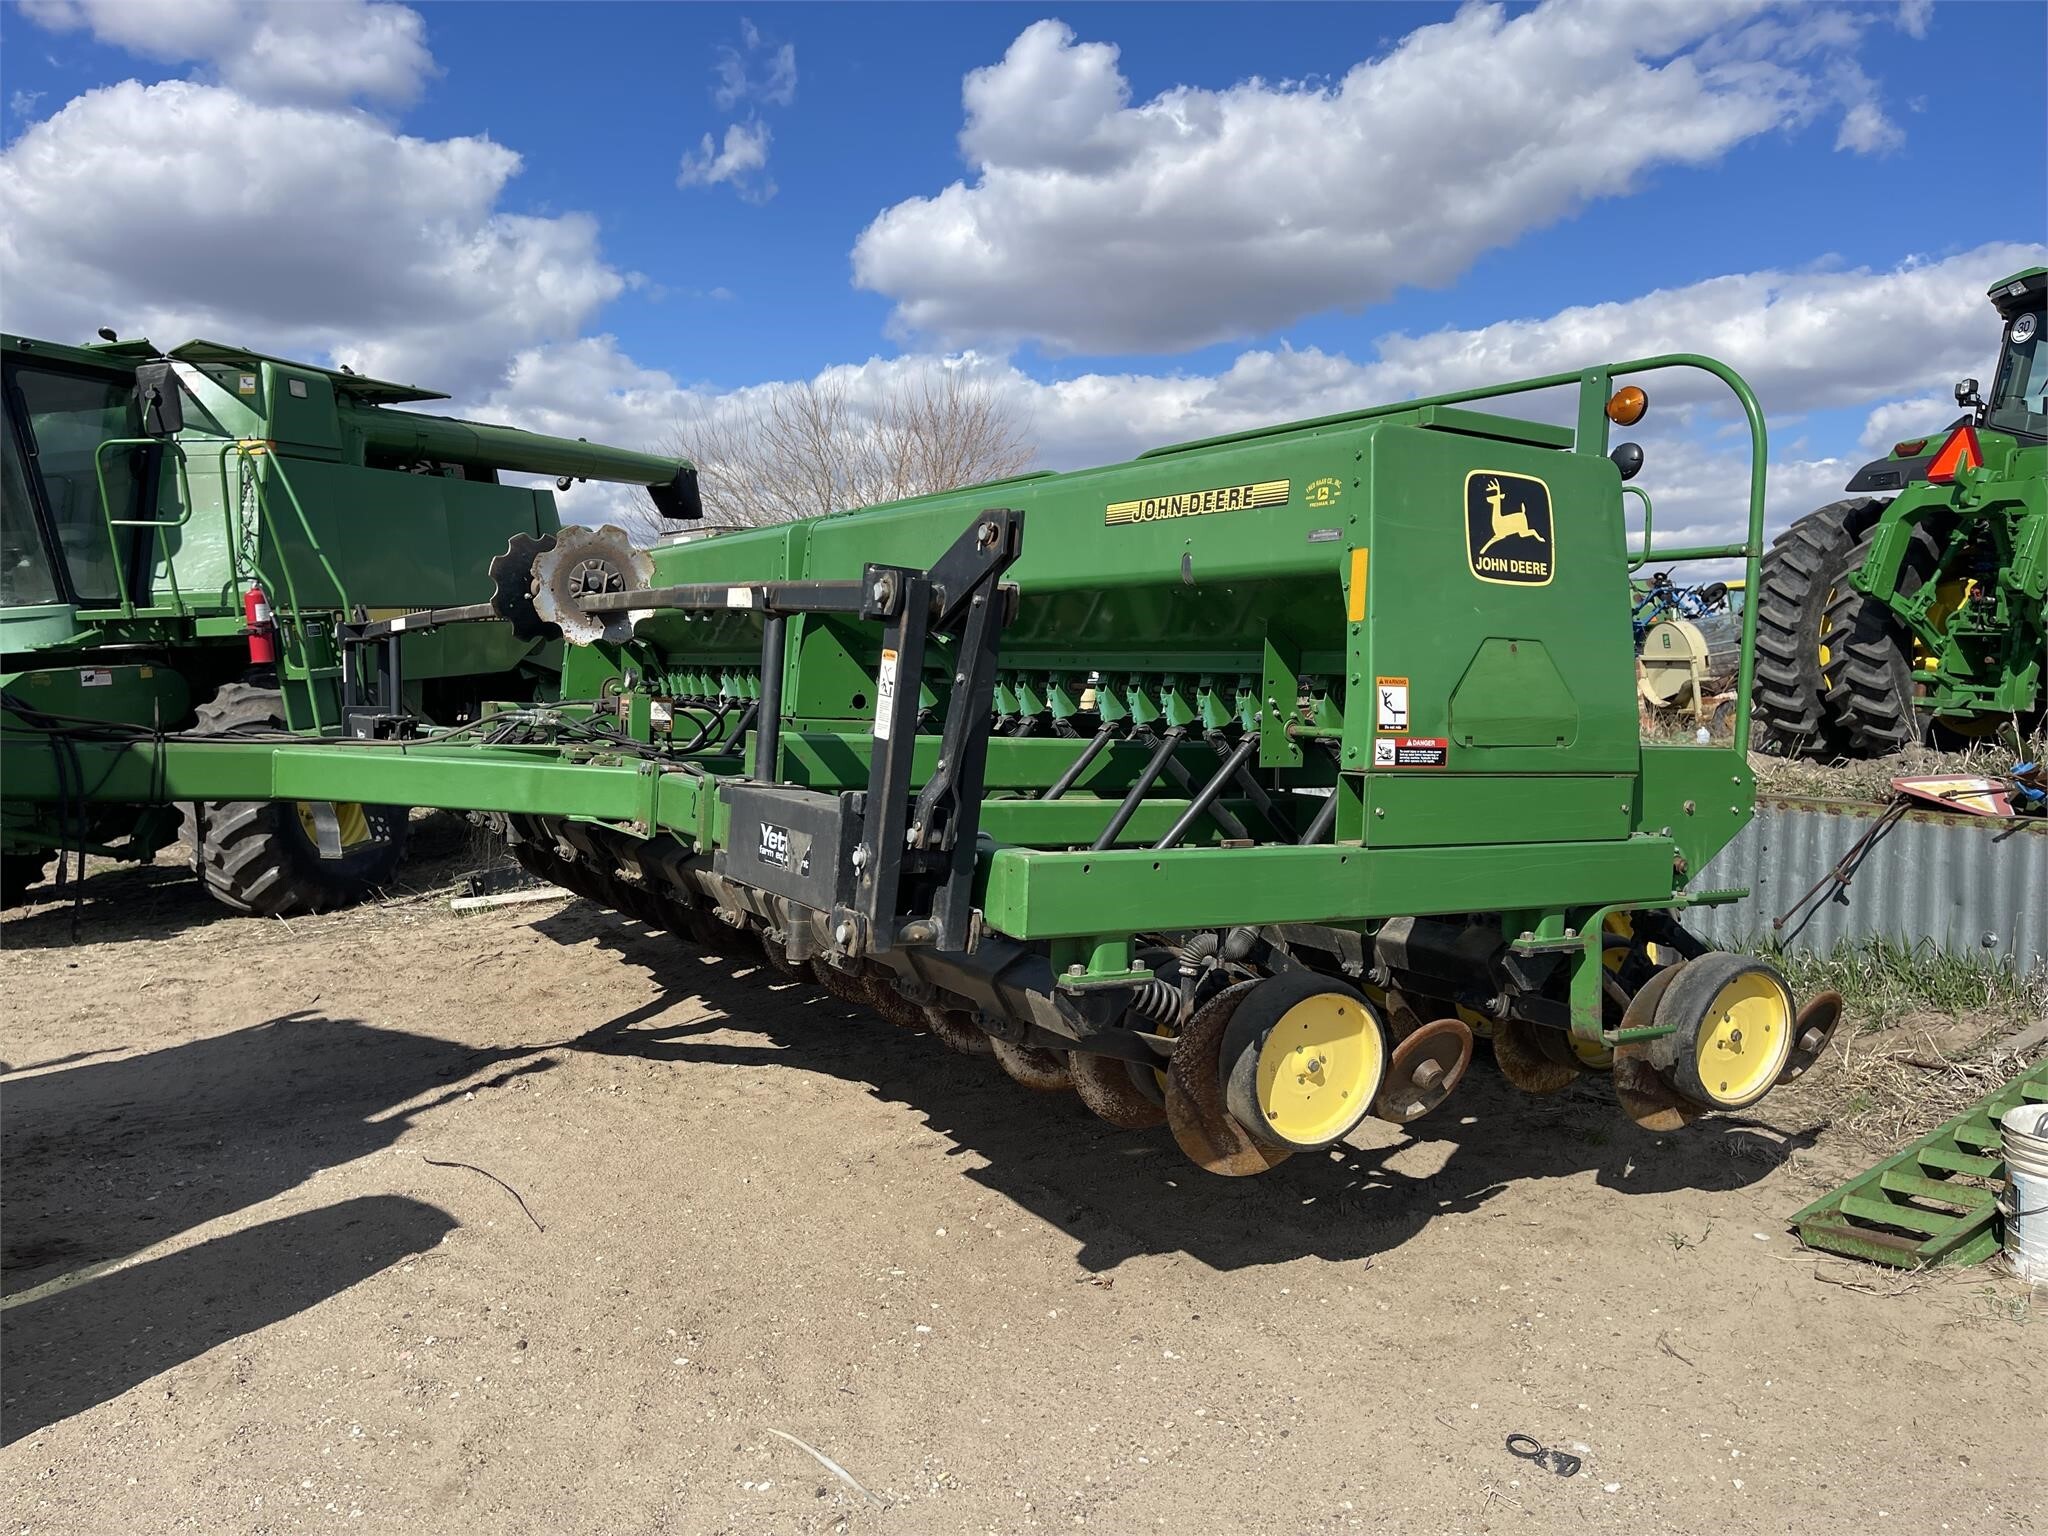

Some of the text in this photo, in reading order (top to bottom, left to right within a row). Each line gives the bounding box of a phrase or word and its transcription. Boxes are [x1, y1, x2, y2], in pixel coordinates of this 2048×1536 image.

[2018, 320, 2031, 333] 30
[1132, 486, 1254, 521] JOHN DEERE
[1476, 557, 1547, 575] JOHN DEERE
[1412, 739, 1436, 747] DANGER
[759, 844, 774, 858] farm
